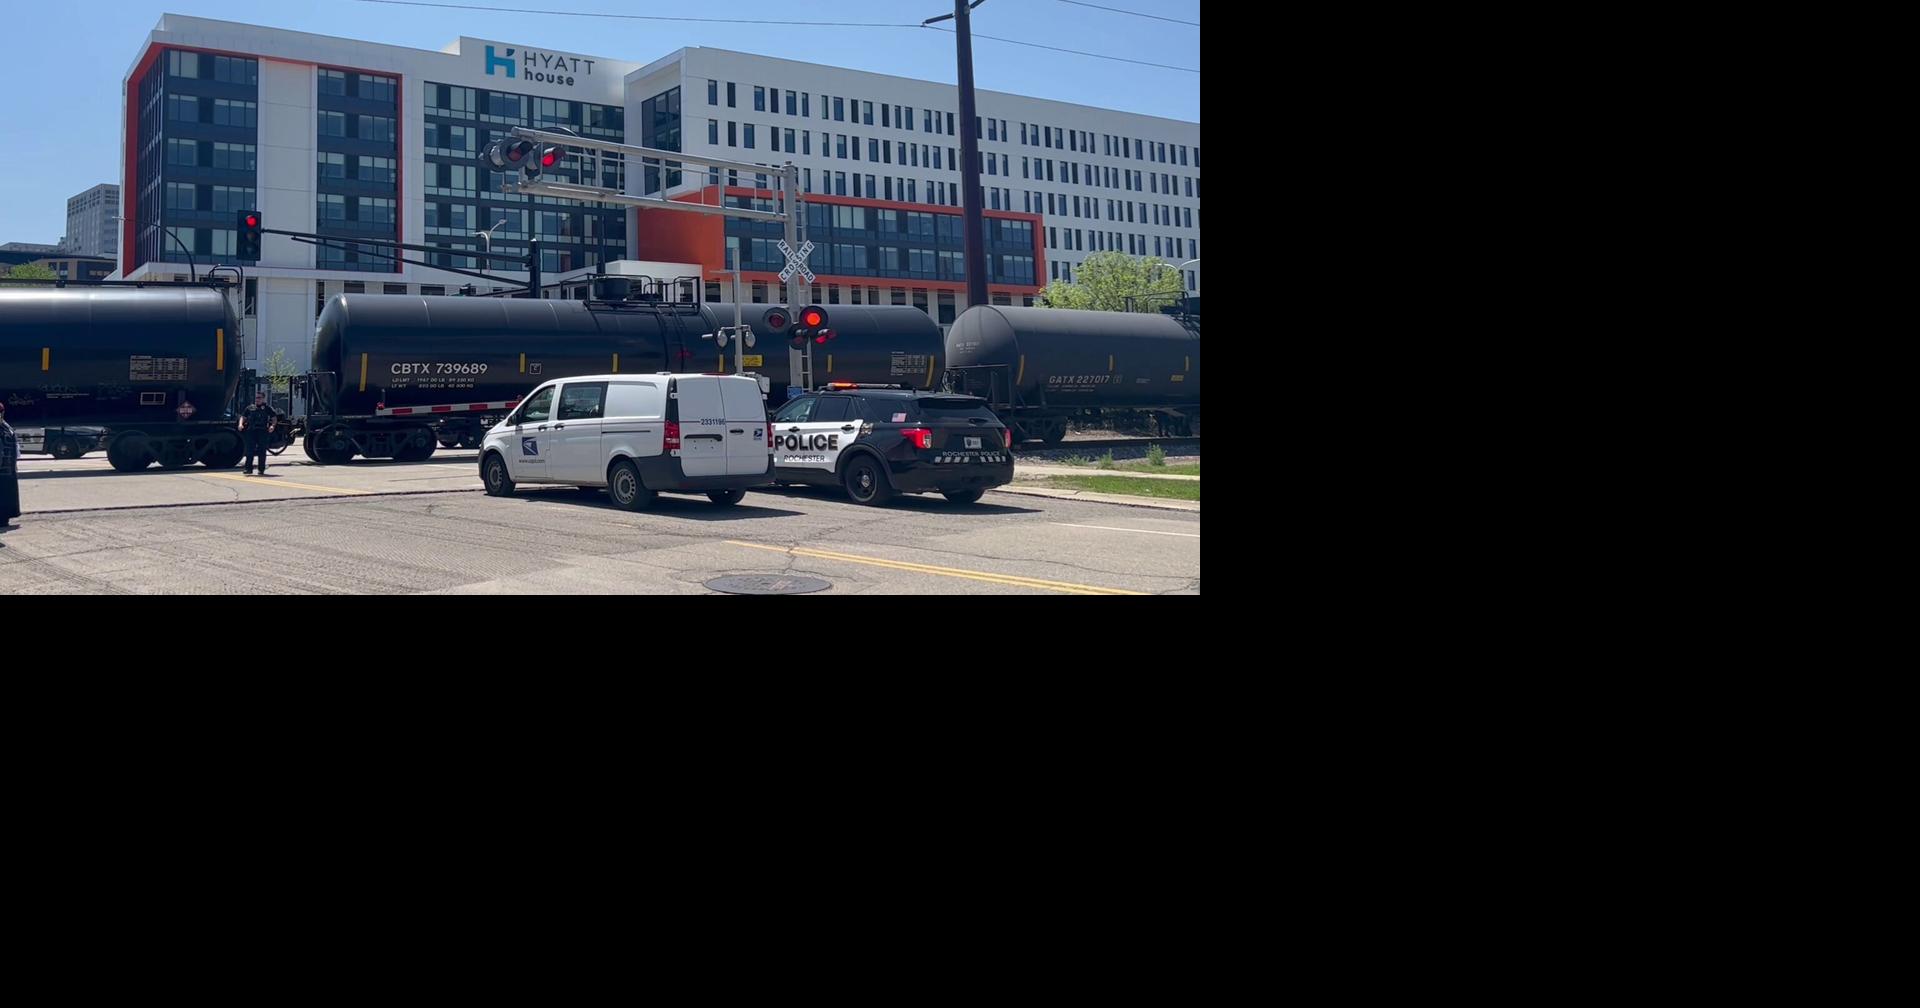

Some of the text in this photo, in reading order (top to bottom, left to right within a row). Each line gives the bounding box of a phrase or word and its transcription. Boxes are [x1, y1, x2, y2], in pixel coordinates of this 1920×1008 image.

[524, 51, 595, 75] HYATT
[524, 67, 575, 86] house
[780, 242, 813, 280] CROSSING
[391, 363, 488, 374] CBTX 739689
[1049, 376, 1074, 384] GATX
[1077, 375, 1110, 384] 227017
[775, 434, 839, 451] POLICE
[784, 454, 825, 462] ROCHESTER
